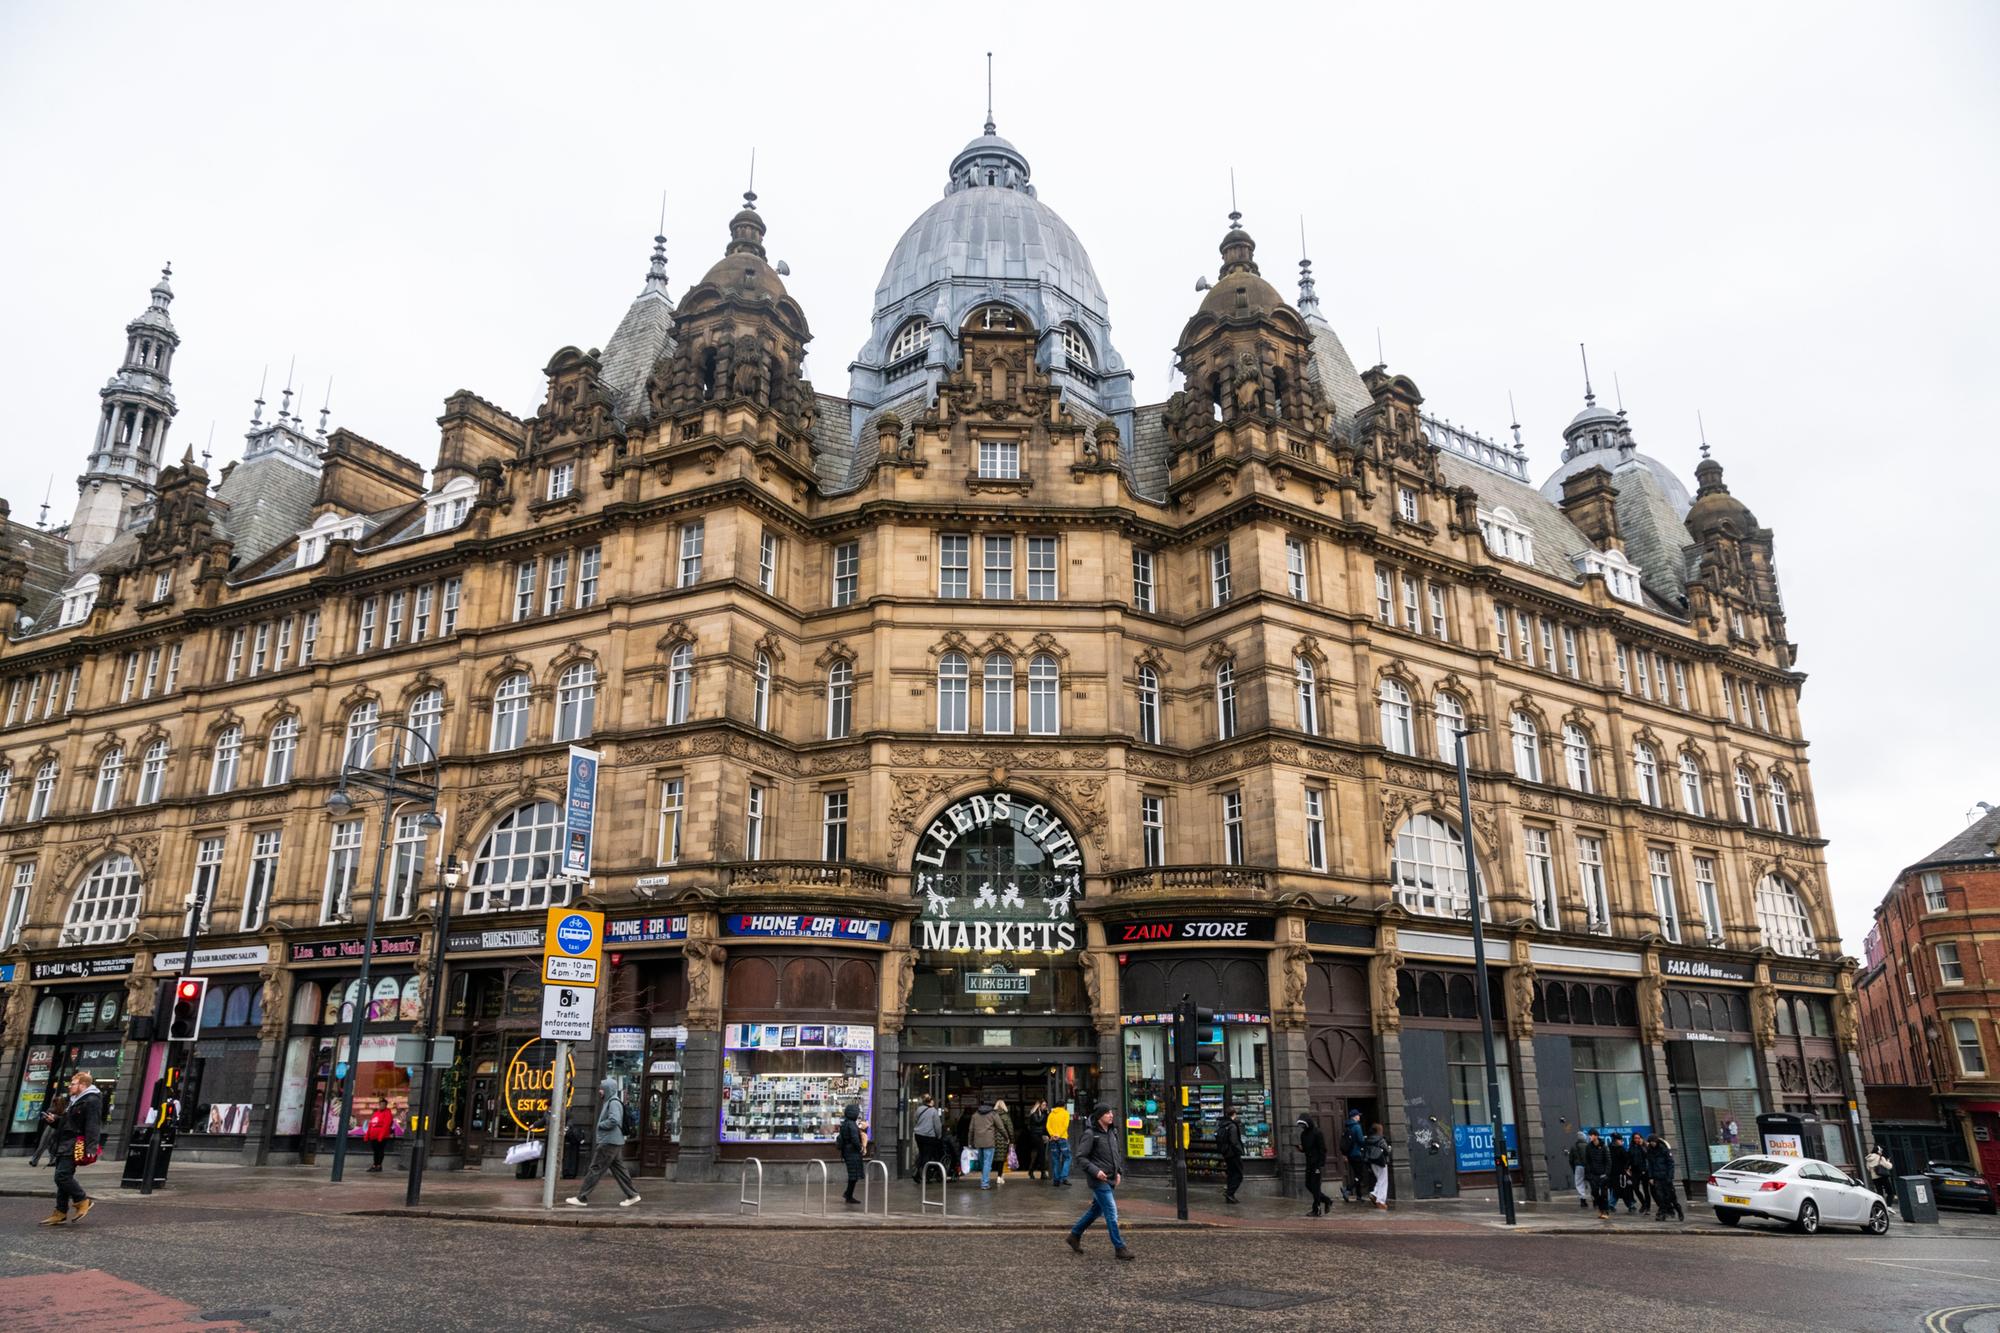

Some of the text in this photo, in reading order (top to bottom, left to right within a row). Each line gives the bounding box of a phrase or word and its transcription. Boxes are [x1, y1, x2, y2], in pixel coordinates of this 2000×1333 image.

[571, 799, 591, 809] TO LET
[915, 793, 1082, 868] LEEDS CITY
[605, 917, 687, 936] PHONE FOR YOU
[741, 915, 869, 934] PHONE FOR YOU
[922, 921, 1076, 951] MARKETS
[1123, 922, 1248, 940] ZAIN STORE
[449, 936, 481, 946] TATTOO
[293, 946, 314, 959] Lisa
[340, 941, 365, 956] Nails
[381, 939, 416, 954] Beauty
[211, 953, 238, 961] BRAIDING
[239, 952, 258, 960] SALON
[573, 961, 581, 969] 10
[1667, 960, 1691, 975] FAFA
[1692, 962, 1709, 976] CHA
[970, 978, 1025, 989] KIRKGATE
[557, 1010, 580, 1019] Traffic
[544, 1019, 590, 1028] enforcement
[32, 1051, 47, 1060] 20
[512, 1061, 567, 1090] Rud
[1193, 1066, 1201, 1078] 4
[517, 1100, 534, 1111] EST
[1469, 1135, 1498, 1149] TO LE
[1769, 1138, 1797, 1148] Dubai
